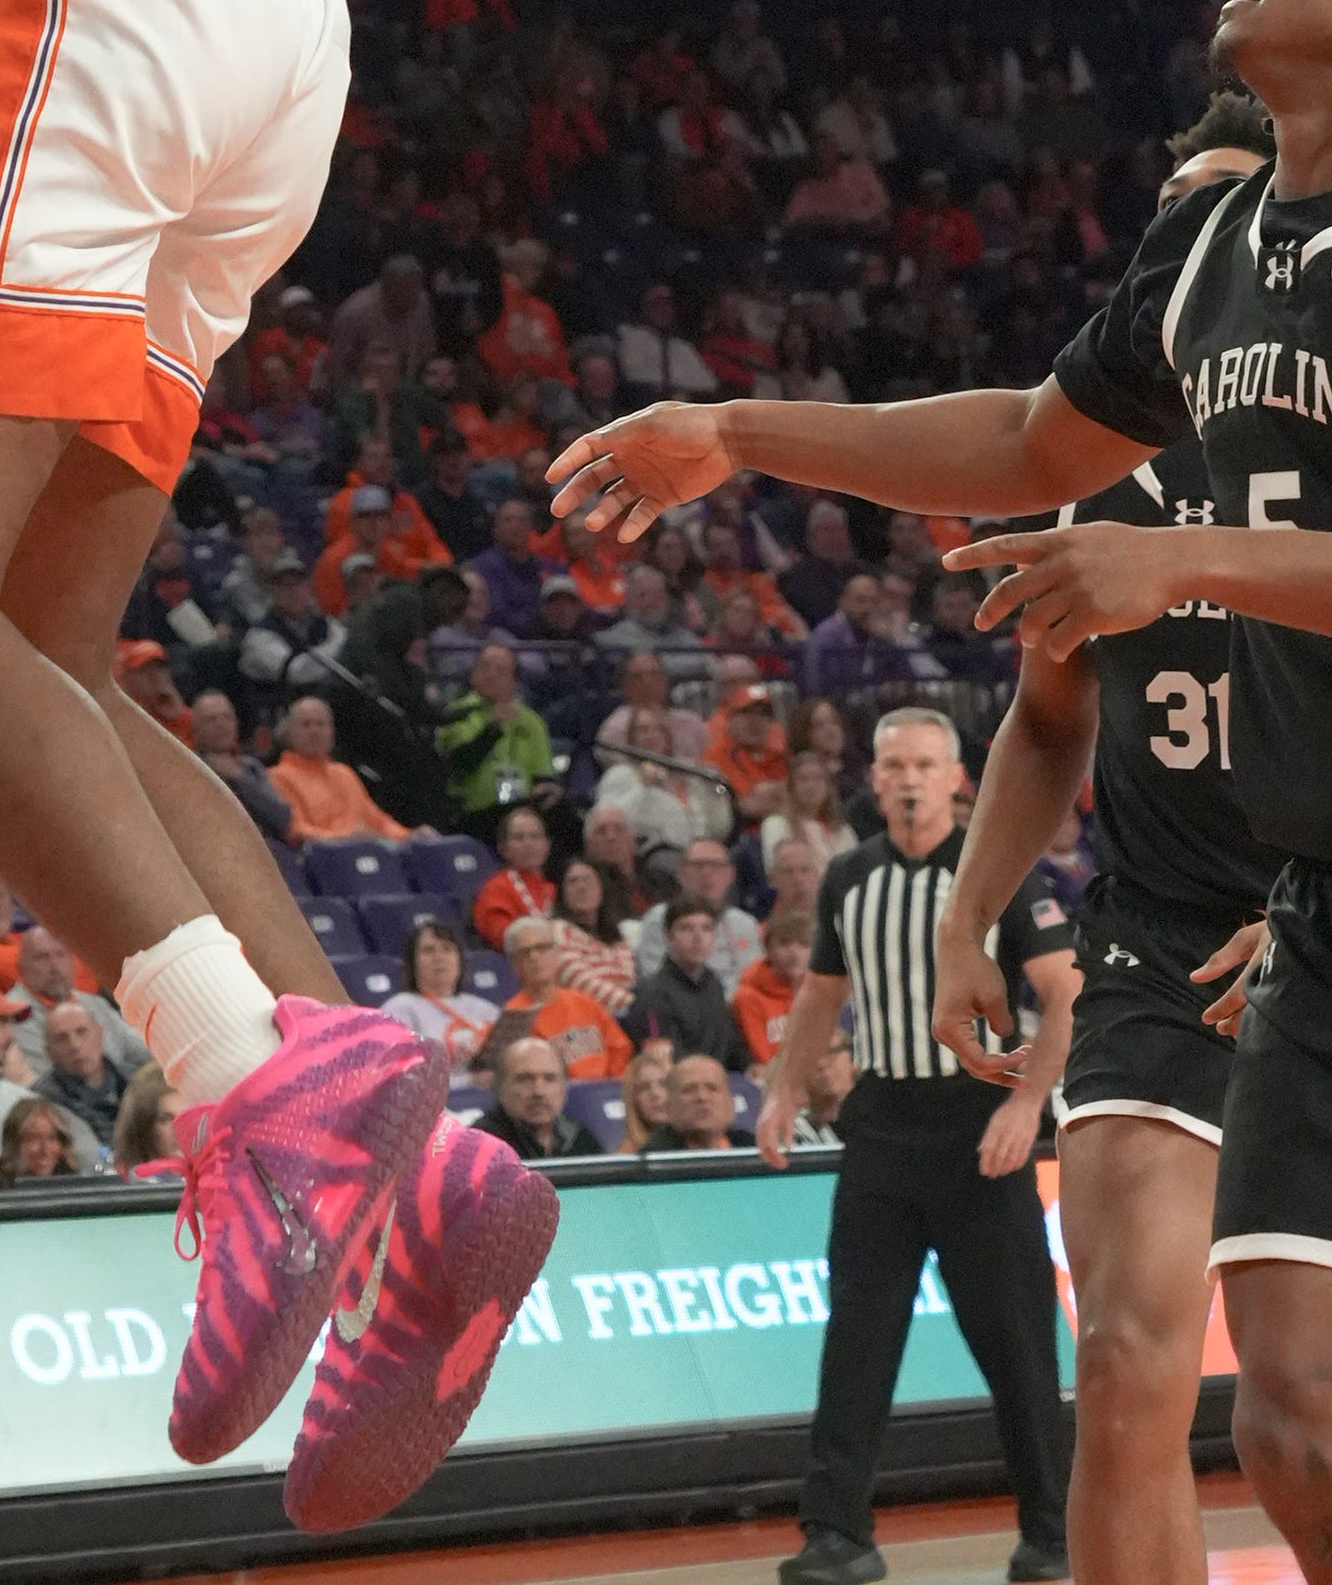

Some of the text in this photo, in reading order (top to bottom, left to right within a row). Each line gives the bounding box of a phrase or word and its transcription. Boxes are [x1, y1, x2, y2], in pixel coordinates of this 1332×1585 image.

[1145, 670, 1232, 770] 31
[9, 1309, 168, 1384] OLD
[570, 1256, 831, 1340] FREIGH
